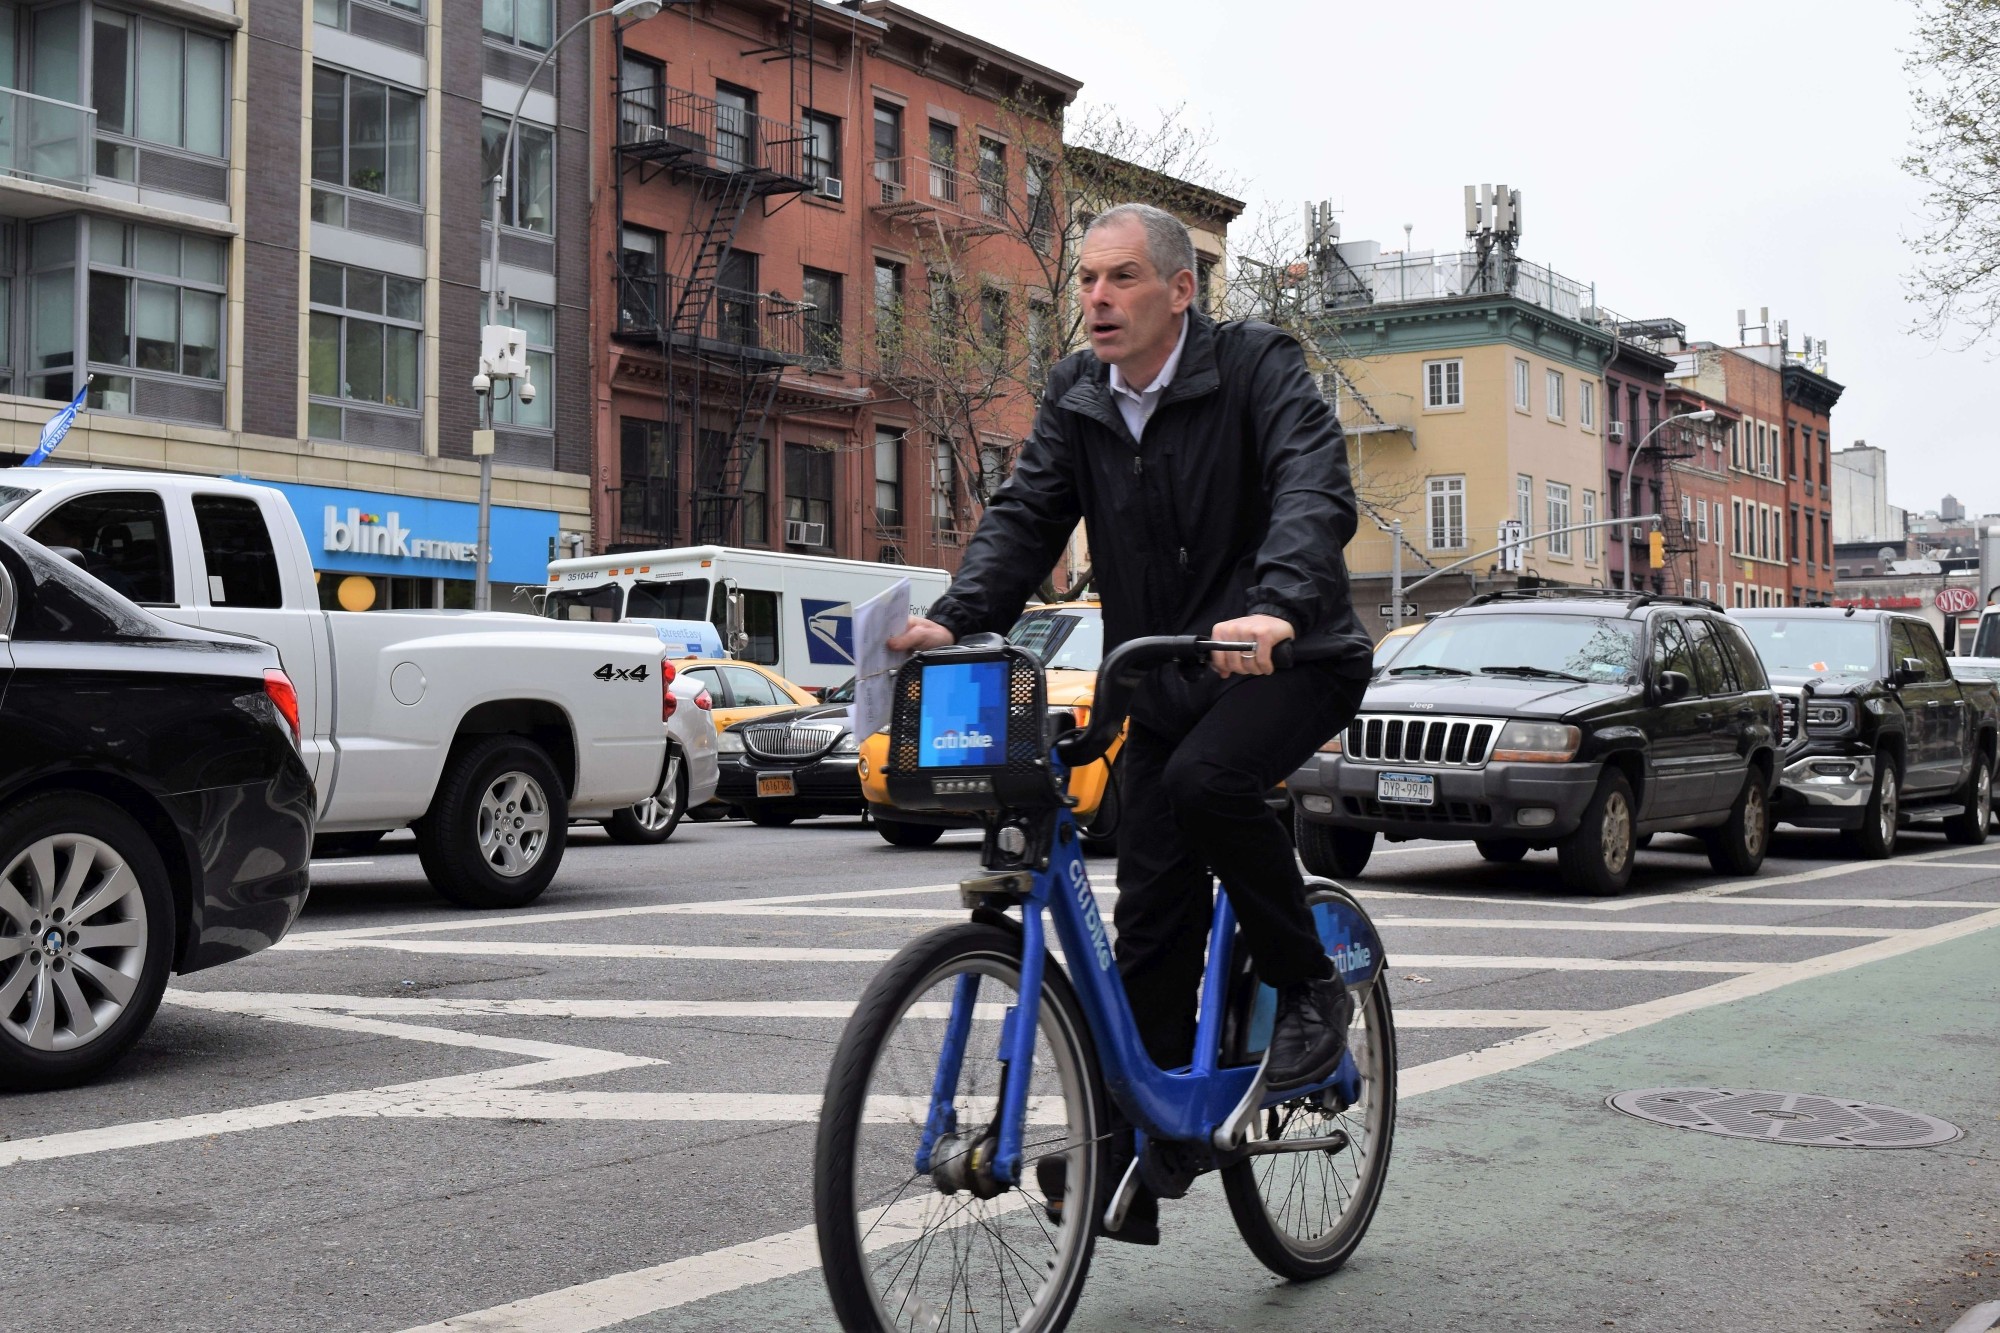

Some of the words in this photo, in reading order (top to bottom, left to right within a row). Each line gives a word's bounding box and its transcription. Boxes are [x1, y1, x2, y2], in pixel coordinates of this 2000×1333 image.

[324, 505, 411, 556] blink
[411, 538, 493, 564] FITNES
[567, 571, 599, 582] 3510447
[1940, 589, 1972, 612] NYSC
[909, 604, 920, 616] For
[660, 627, 702, 641] StreetEasy
[593, 663, 650, 682] 4x4
[1409, 702, 1434, 710] Jeep
